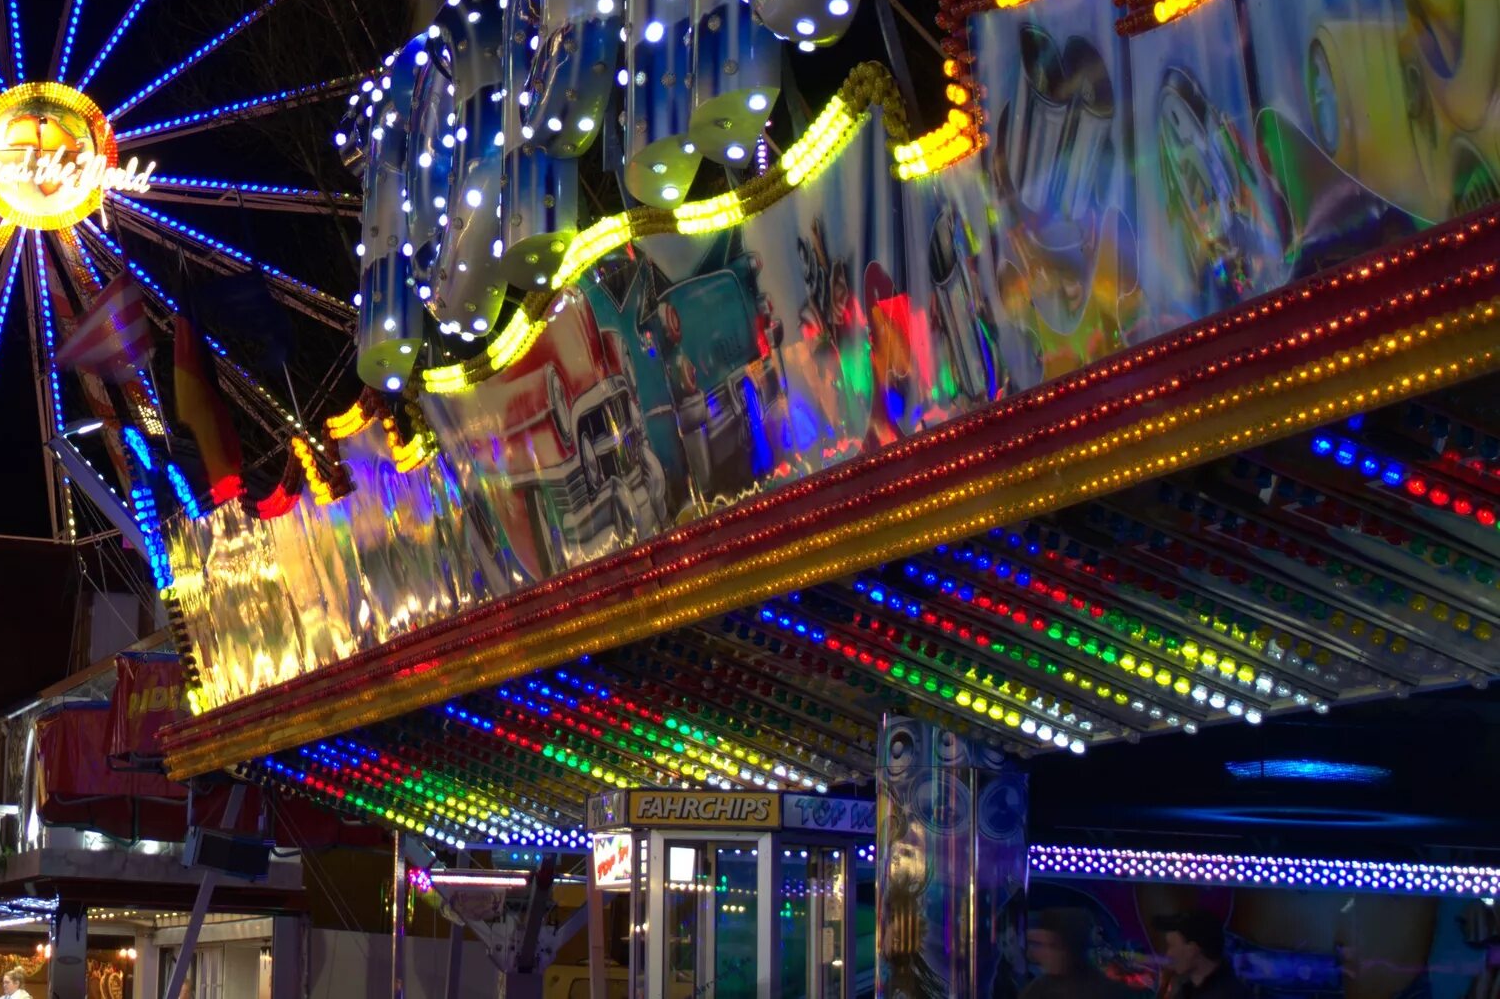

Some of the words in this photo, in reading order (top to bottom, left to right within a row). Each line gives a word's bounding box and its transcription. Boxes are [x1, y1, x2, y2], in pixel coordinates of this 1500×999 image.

[32, 145, 77, 184] the
[60, 151, 157, 194] World
[636, 795, 771, 820] FAHRCHIPS
[794, 797, 846, 828] TOP
